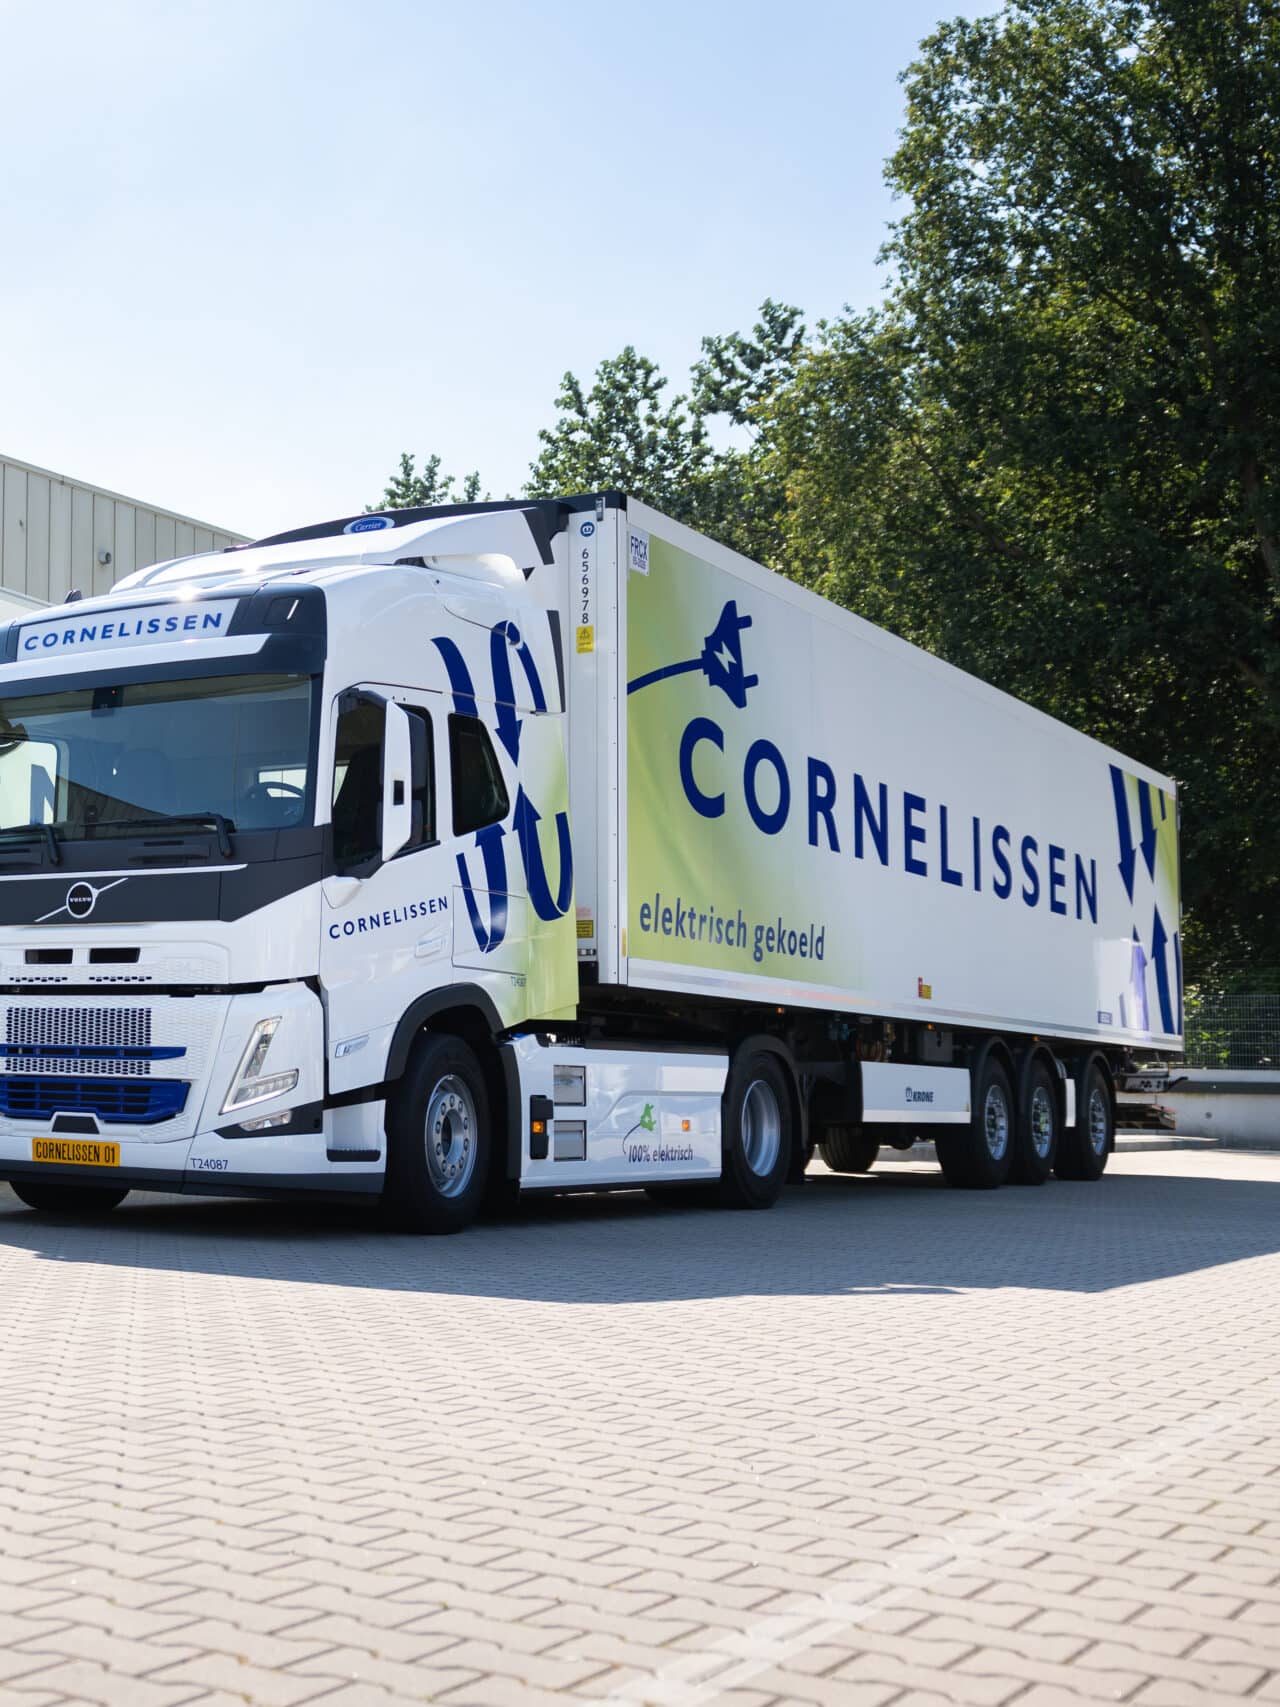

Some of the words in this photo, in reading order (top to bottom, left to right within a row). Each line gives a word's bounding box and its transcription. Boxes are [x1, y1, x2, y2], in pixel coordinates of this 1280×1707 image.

[355, 521, 382, 531] Carrier
[630, 535, 648, 561] FRCX
[581, 548, 589, 624] 656978
[24, 613, 222, 650] CORNELISSEN
[678, 716, 1098, 924] CORNELISSEN
[329, 895, 448, 939] CORNELISSEN
[640, 893, 747, 948] elektrisch
[753, 917, 825, 962] gekoeld
[912, 1091, 934, 1102] KRONE
[35, 1141, 100, 1163] CORNELISSEN
[104, 1146, 116, 1163] 01
[190, 1157, 229, 1170] T24087
[628, 1144, 651, 1163] 100%
[652, 1144, 693, 1161] elektrisch
